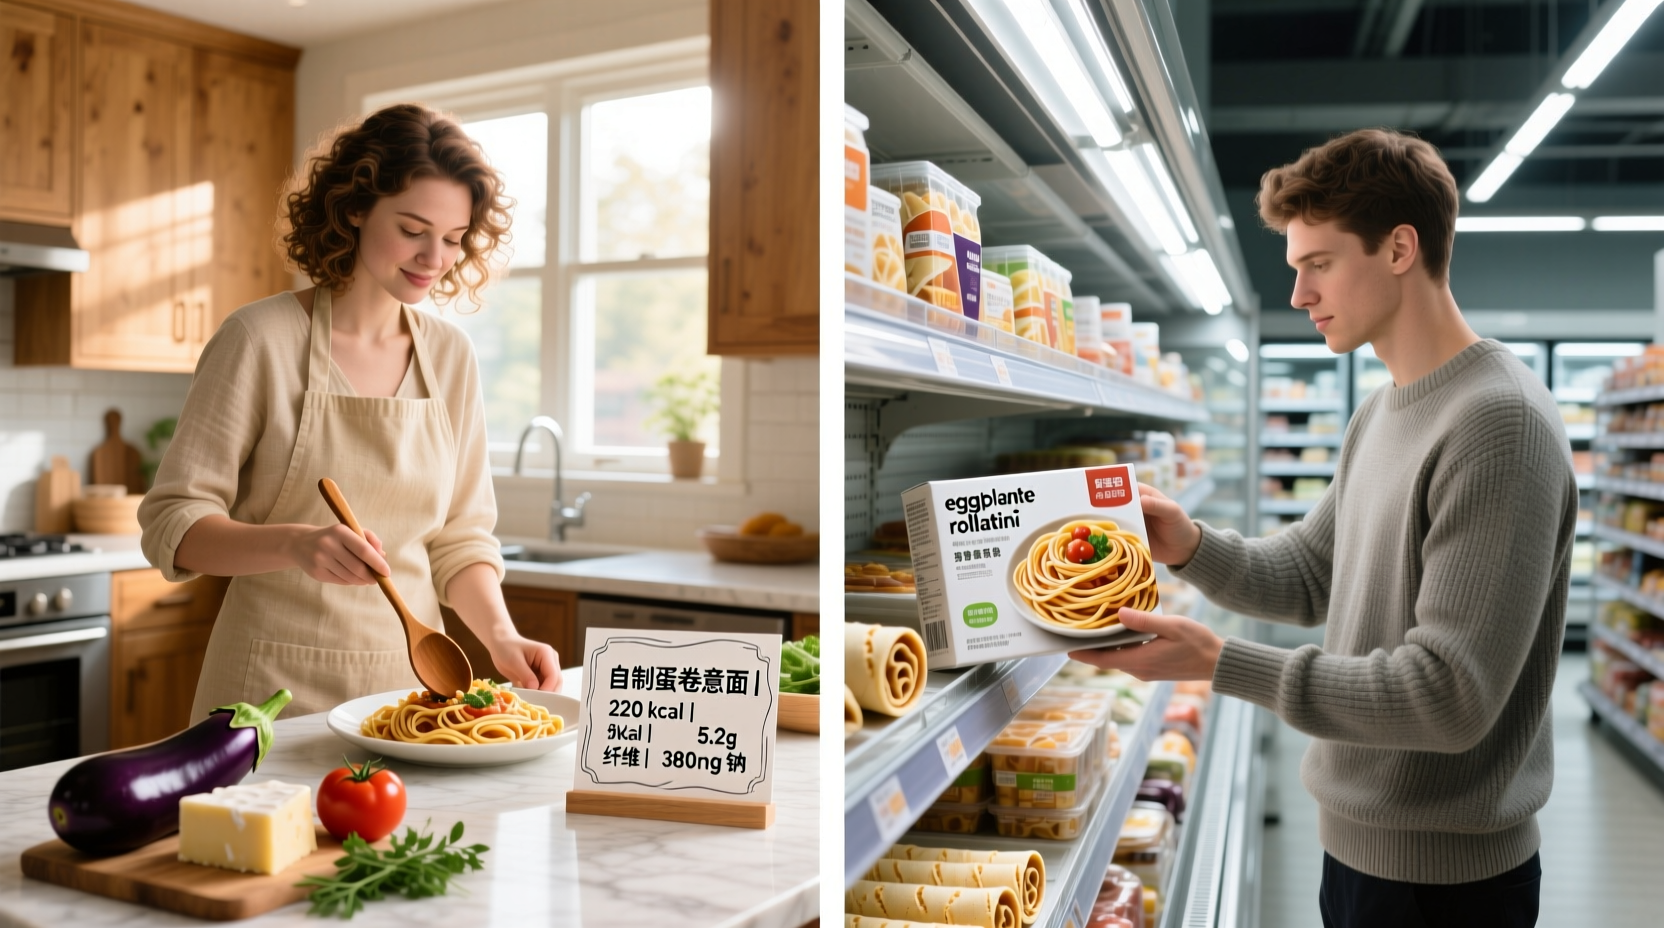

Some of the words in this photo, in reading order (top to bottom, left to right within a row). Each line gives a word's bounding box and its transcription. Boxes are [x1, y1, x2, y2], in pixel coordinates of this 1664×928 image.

[945, 487, 1035, 514] eggplante
[949, 509, 1020, 534] rollatini
[610, 664, 750, 695] 自制蛋卷意面
[608, 699, 643, 718] 220
[648, 701, 684, 720] kcal
[697, 726, 738, 751] 5.2g
[602, 745, 641, 768] 纤维
[661, 750, 722, 775] 380ng
[725, 751, 747, 774] 钠
